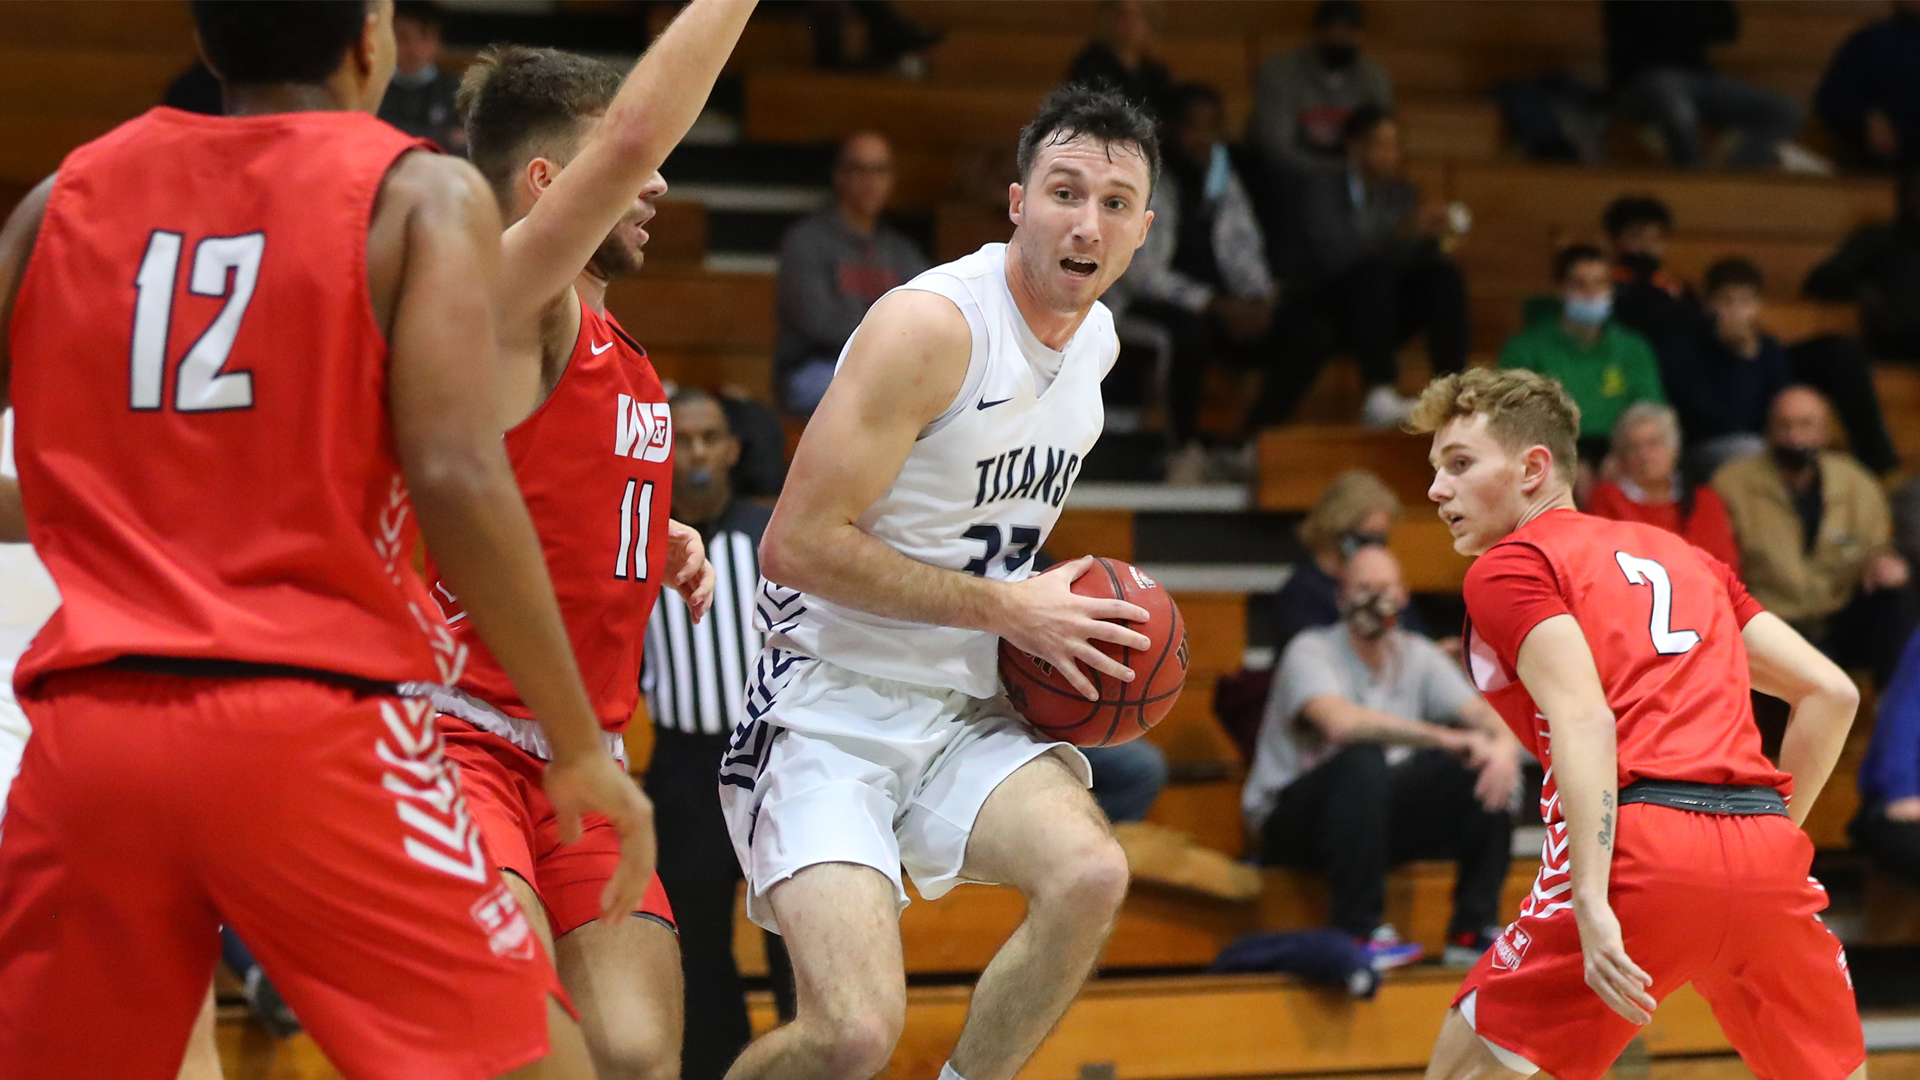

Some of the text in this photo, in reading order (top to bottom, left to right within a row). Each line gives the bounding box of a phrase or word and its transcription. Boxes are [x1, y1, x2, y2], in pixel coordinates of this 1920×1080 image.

[129, 228, 266, 414] 12
[614, 477, 654, 582] 11
[973, 445, 1079, 509] TITANS
[1614, 550, 1702, 656] 2
